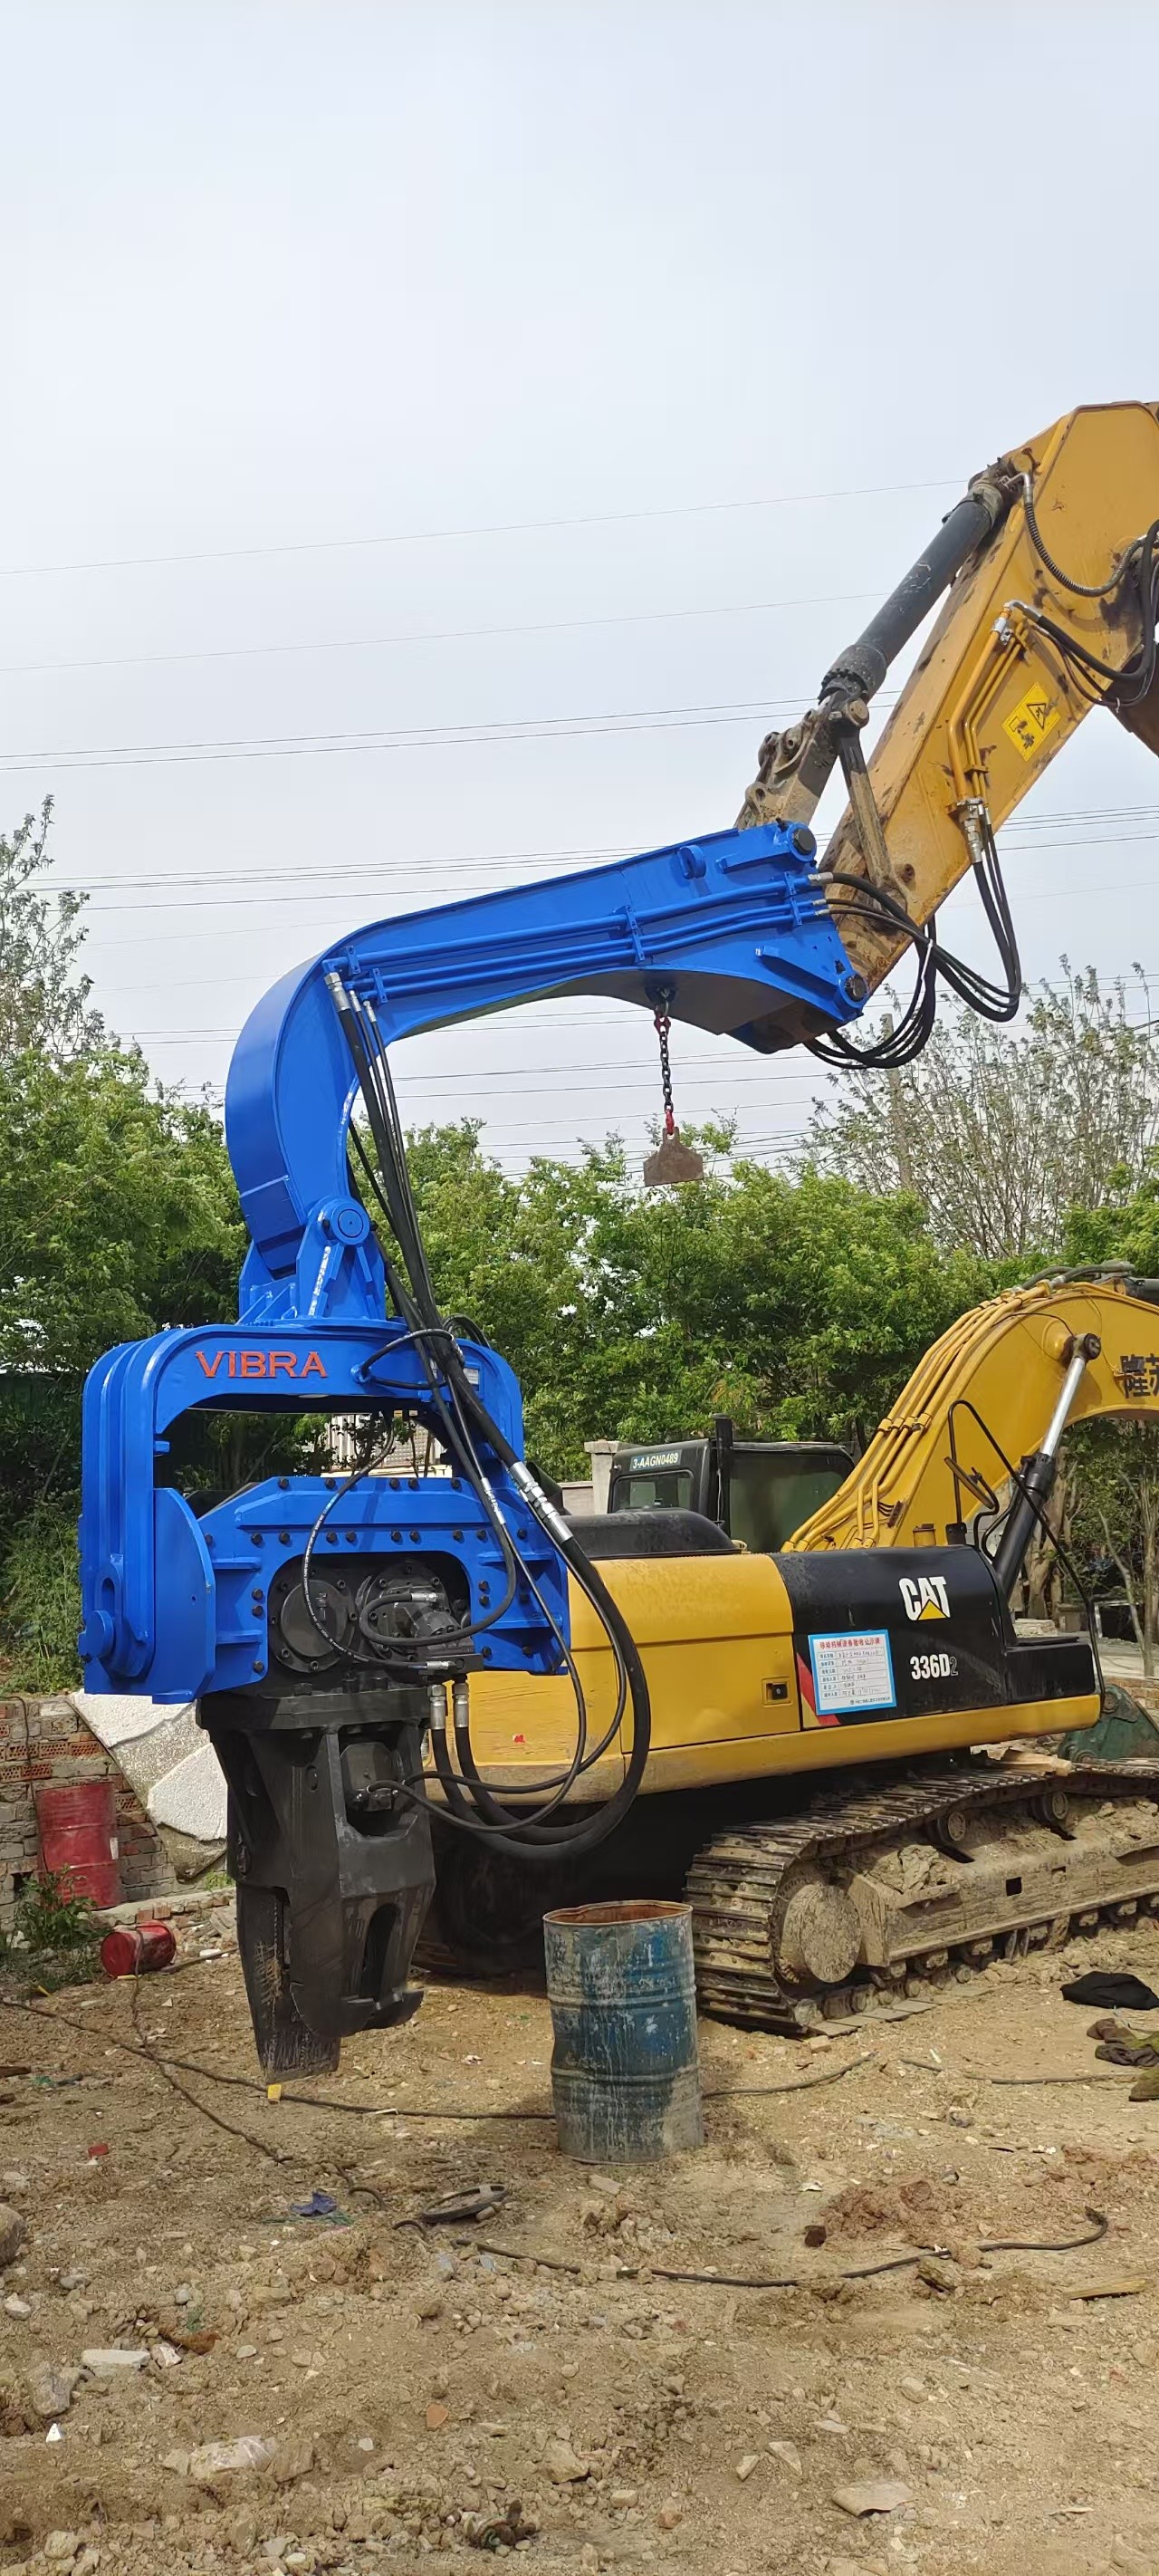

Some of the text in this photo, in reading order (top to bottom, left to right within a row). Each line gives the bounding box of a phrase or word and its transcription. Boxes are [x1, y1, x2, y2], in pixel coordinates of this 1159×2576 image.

[196, 1350, 328, 1378] VIBRA
[632, 1453, 679, 1469] 3-AAGN0489
[899, 1576, 951, 1621] CAT
[909, 1653, 959, 1680] 336D2
